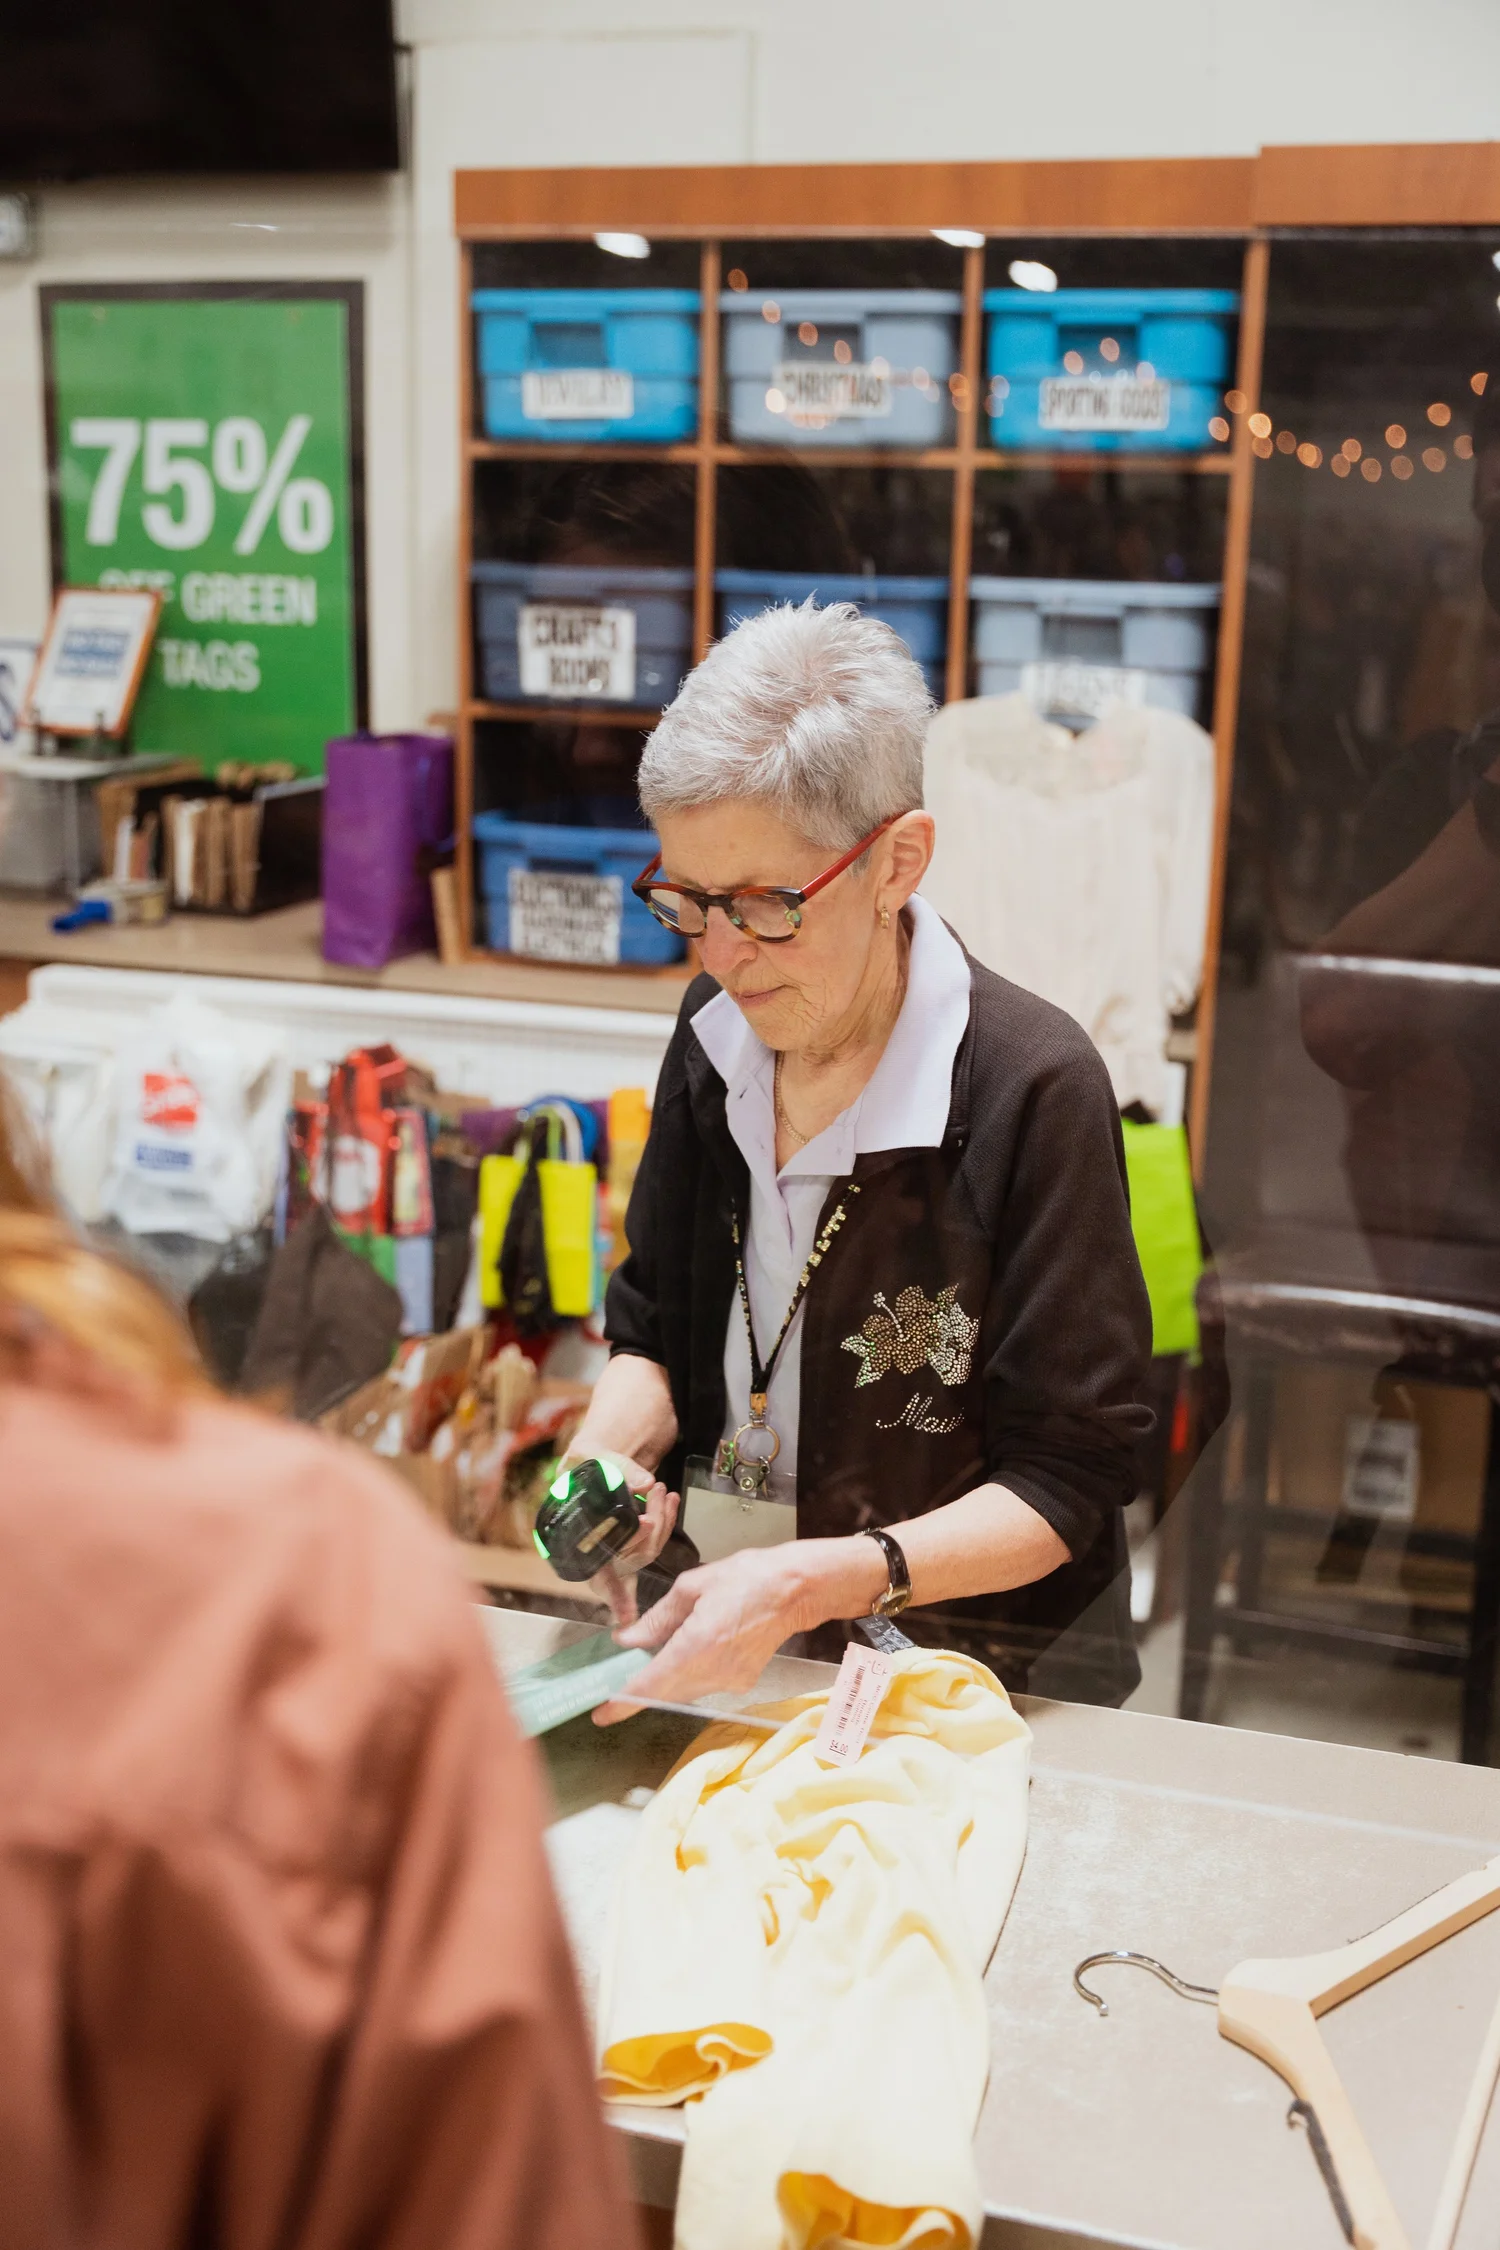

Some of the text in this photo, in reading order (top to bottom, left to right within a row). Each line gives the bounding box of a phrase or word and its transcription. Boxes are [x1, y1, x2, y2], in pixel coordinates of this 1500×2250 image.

[71, 416, 335, 556] 75%
[181, 570, 317, 626] GREEN
[160, 638, 261, 693] TAGS
